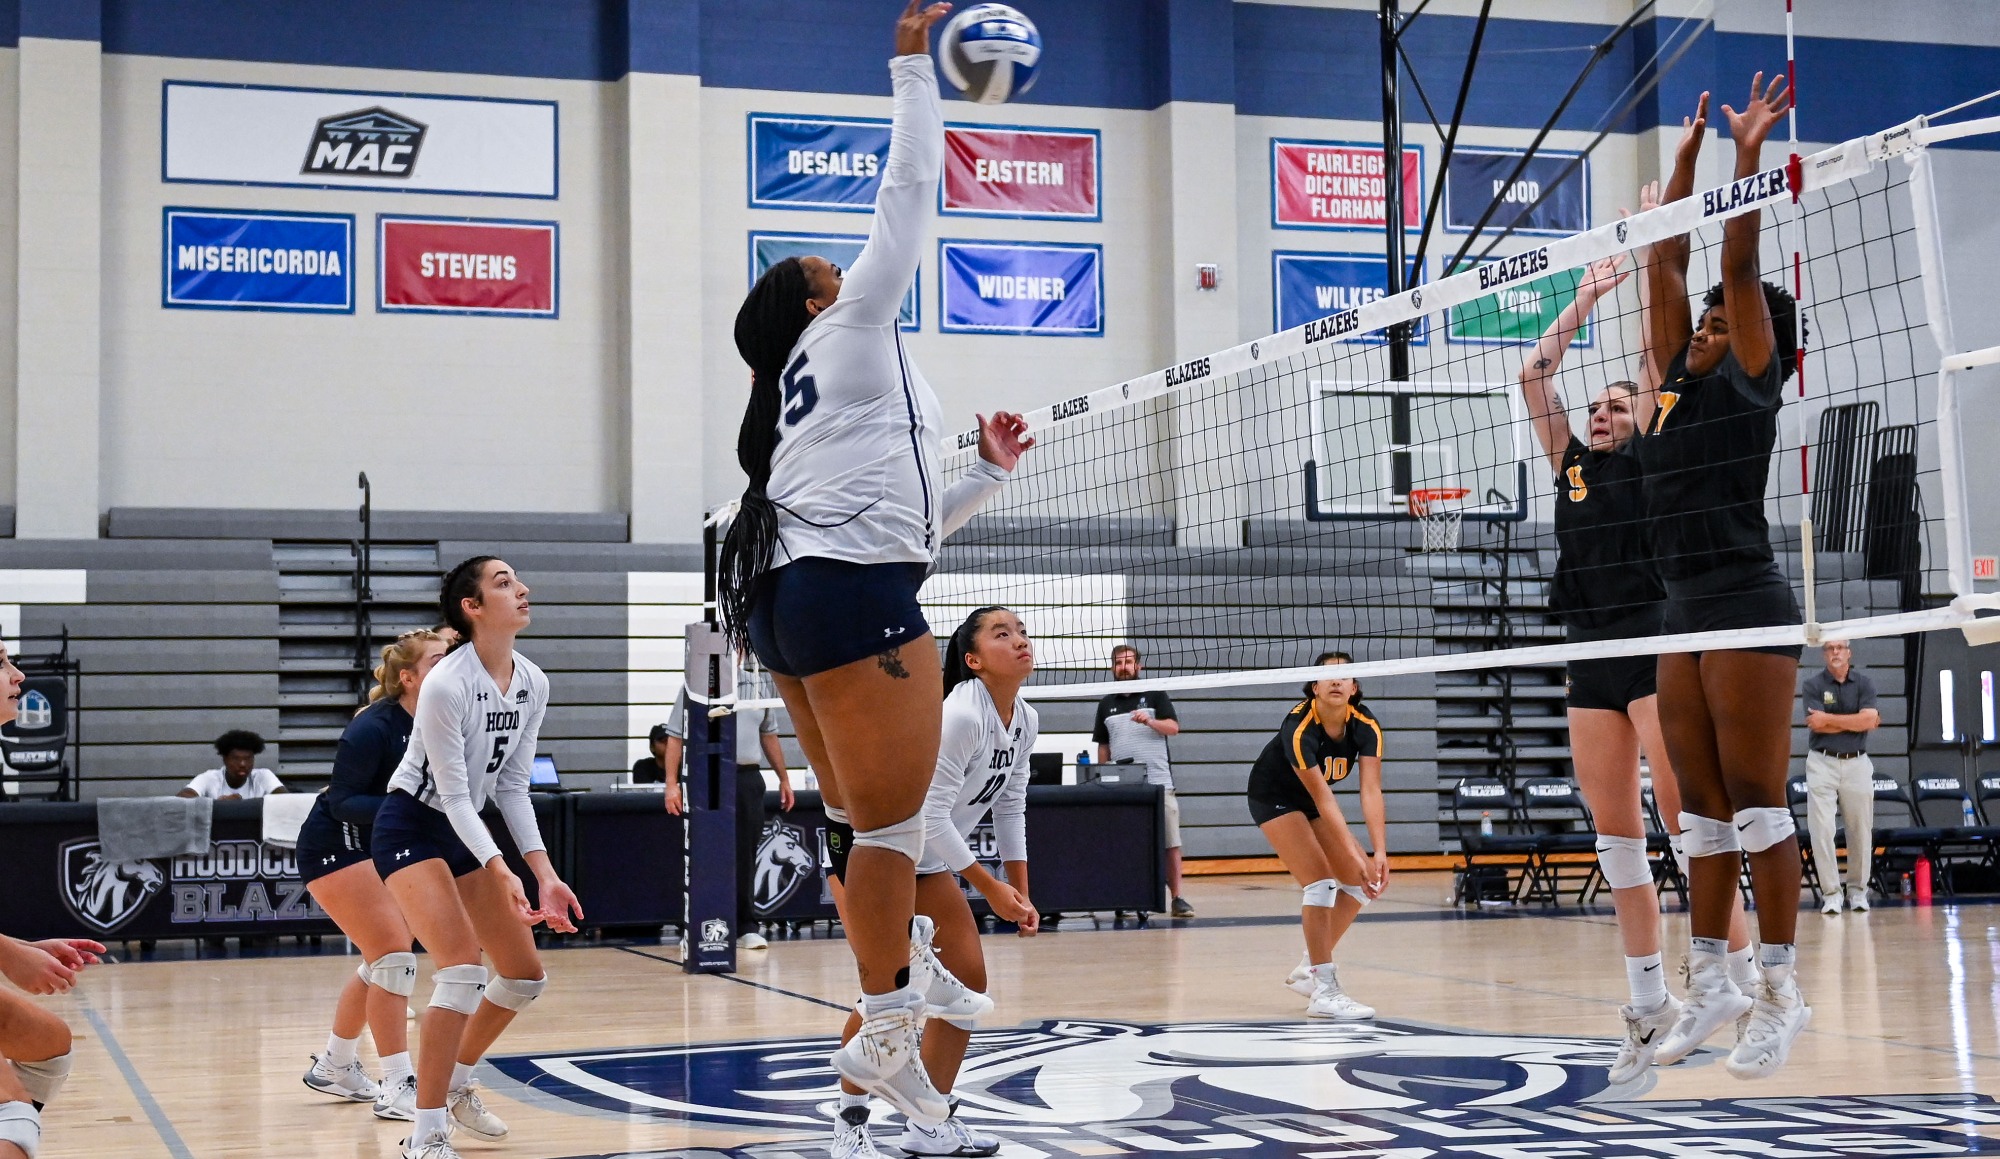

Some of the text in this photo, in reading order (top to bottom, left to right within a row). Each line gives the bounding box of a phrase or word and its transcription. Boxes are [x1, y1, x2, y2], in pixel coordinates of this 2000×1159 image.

[312, 141, 413, 173] MAC
[788, 150, 878, 177] DESALES
[976, 159, 1064, 185] EASTERN
[1493, 179, 1539, 203] HOOD
[1703, 165, 1790, 218] BLAZER
[1311, 198, 1386, 219] FLORHAM
[179, 245, 341, 277] MISERICORDIA
[421, 253, 516, 280] STEVENS
[1479, 247, 1548, 290] BLAZERS
[978, 275, 1066, 301] WIDENER
[1499, 291, 1541, 313] YORK
[1304, 309, 1359, 344] BLAZERS
[1165, 357, 1211, 388] BLAZERS
[1052, 395, 1089, 421] BLAZERS
[1657, 391, 1681, 435] 7
[957, 429, 980, 449] BLAZE
[1974, 559, 1995, 576] EXIT
[486, 710, 520, 732] HOOD
[486, 736, 509, 773] 5
[1323, 756, 1348, 781] 10
[968, 774, 1006, 805] 10
[172, 841, 259, 879] HOOD
[171, 881, 330, 923] BLAZ
